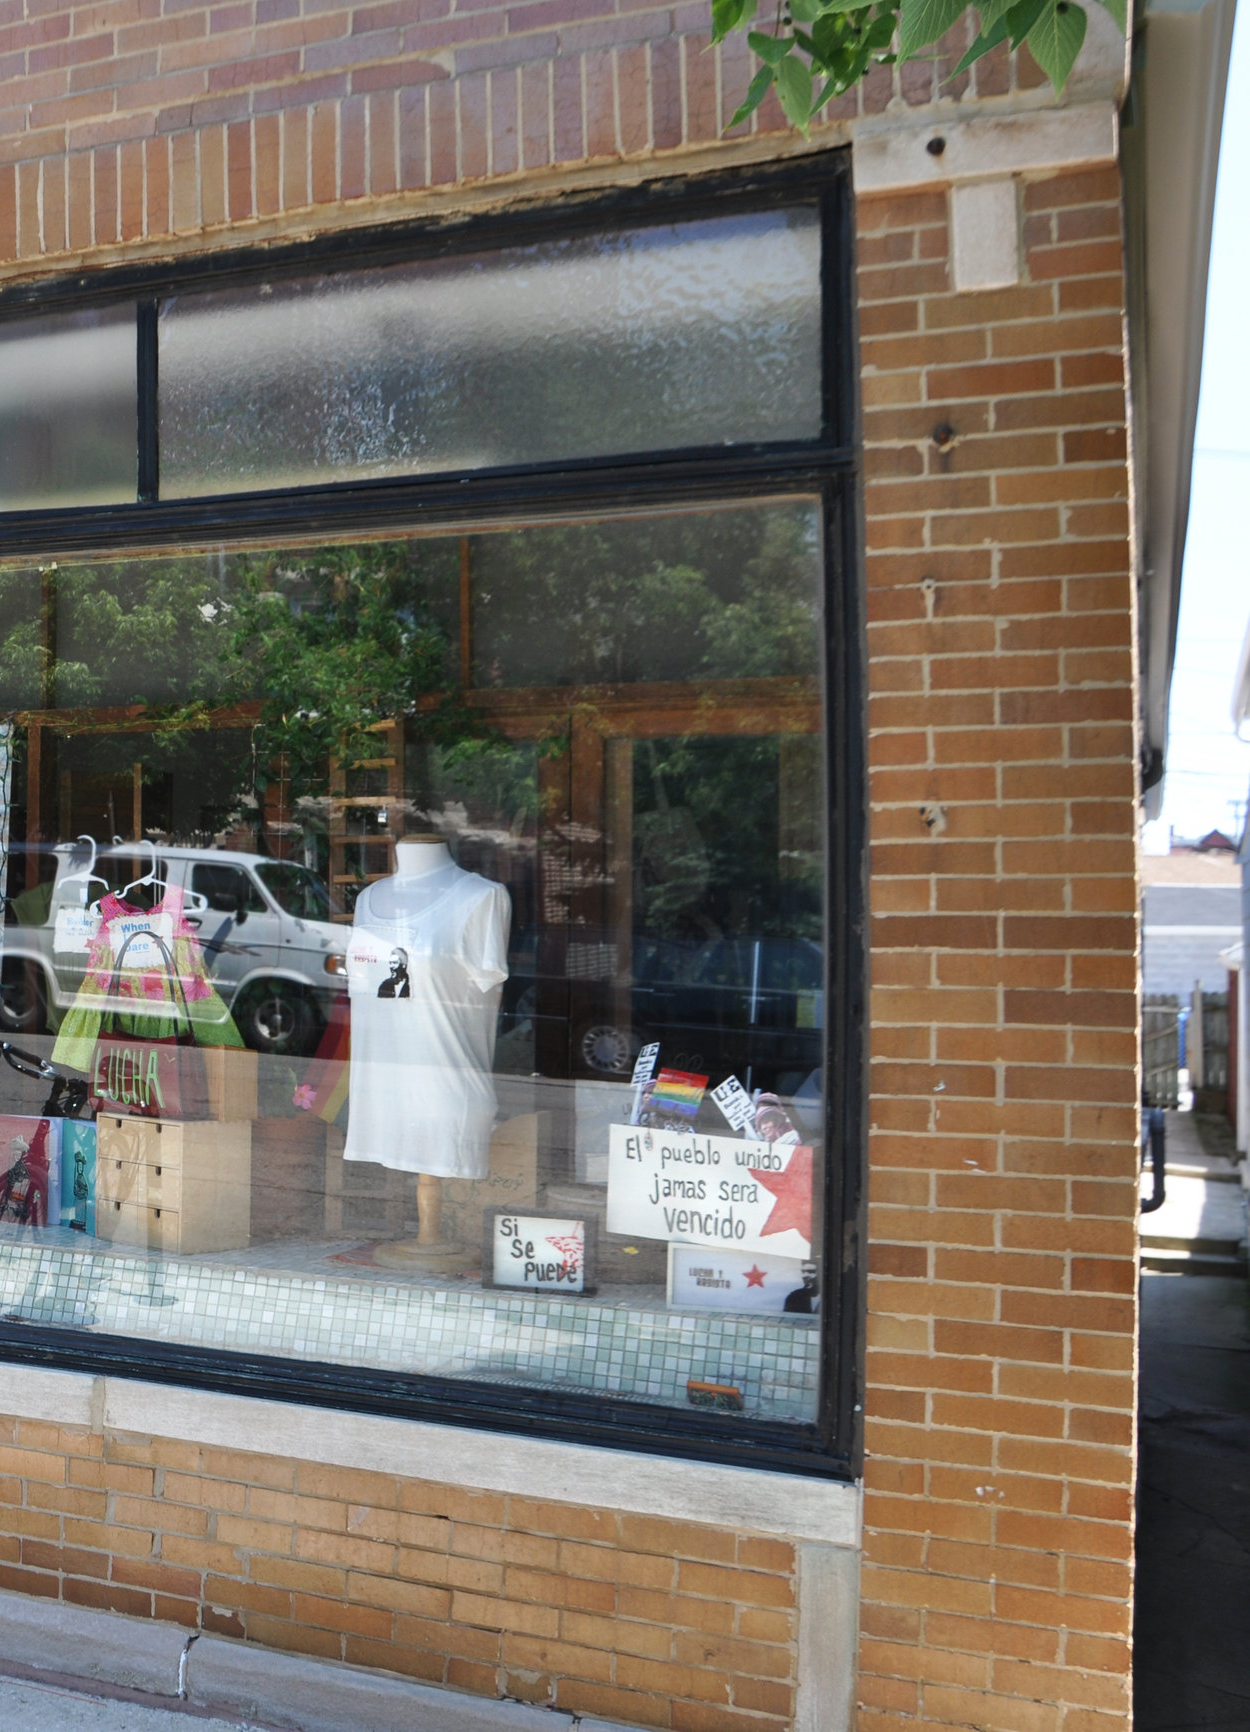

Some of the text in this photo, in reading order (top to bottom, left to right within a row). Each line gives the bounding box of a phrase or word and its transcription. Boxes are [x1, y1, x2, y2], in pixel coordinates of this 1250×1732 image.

[120, 922, 151, 934] When
[93, 1046, 166, 1109] LUCHA
[625, 1135, 782, 1171] El pueblo unido
[649, 1173, 759, 1204] jamas sera
[500, 1218, 518, 1237] Si
[663, 1206, 746, 1240] vencido
[510, 1238, 535, 1259] Se
